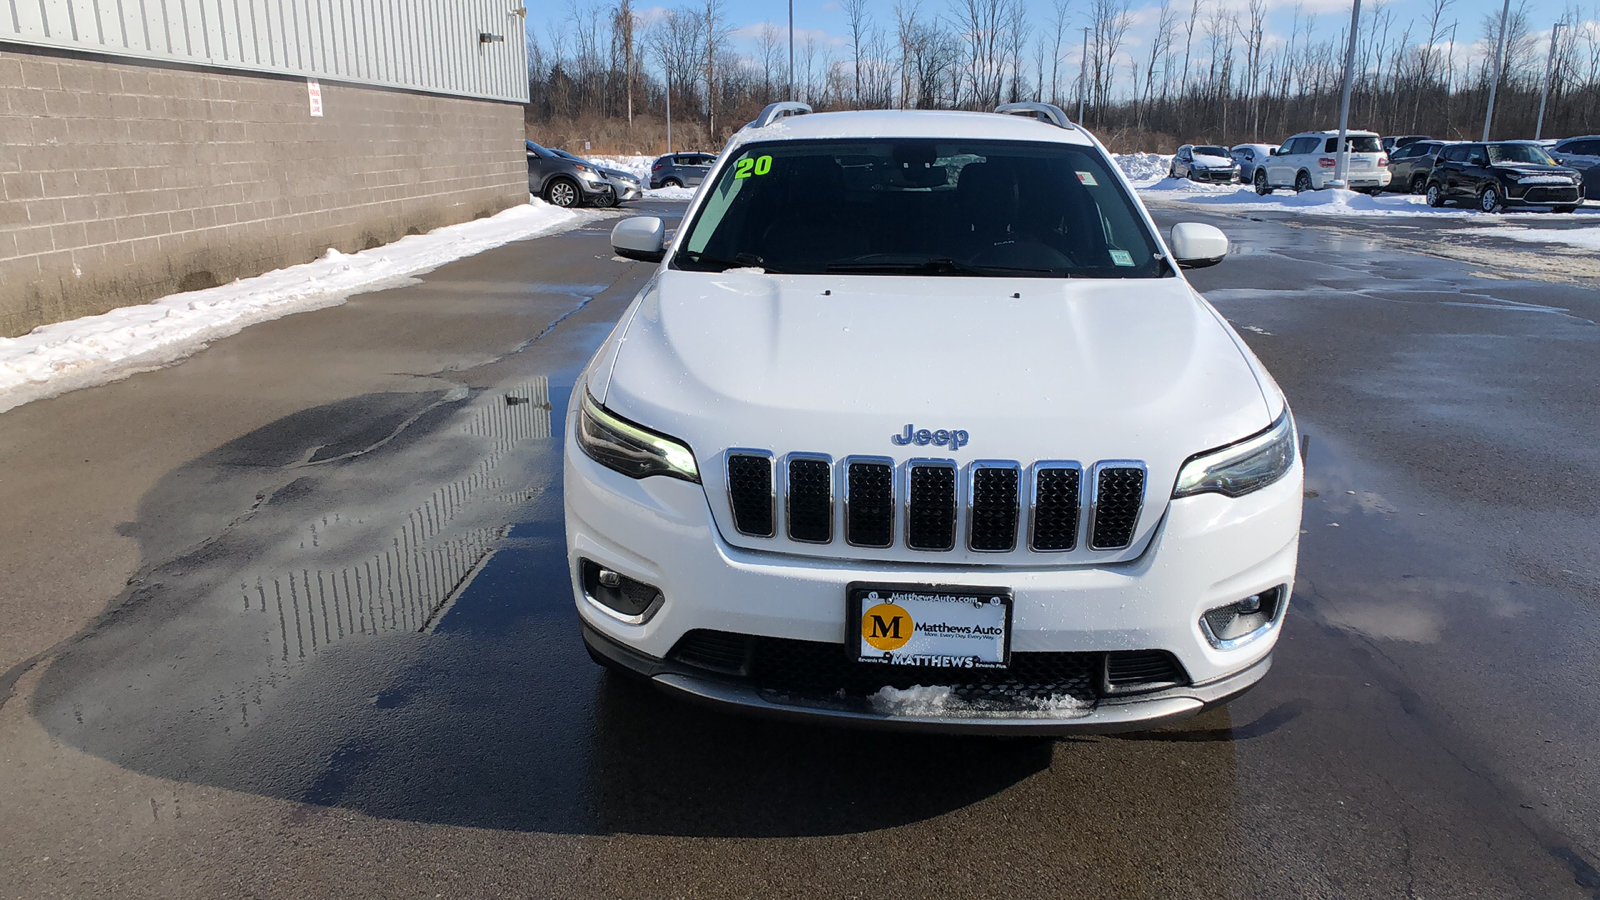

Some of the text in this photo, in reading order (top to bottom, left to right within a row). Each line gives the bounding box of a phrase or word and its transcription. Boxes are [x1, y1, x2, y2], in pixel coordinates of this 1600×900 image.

[735, 155, 773, 180] 20
[890, 423, 970, 452] Jeep
[891, 592, 978, 603] MatthewsAuto.com
[868, 614, 904, 639] M
[914, 622, 1003, 635] Matthews Auto
[890, 653, 974, 669] MATTHEWS
